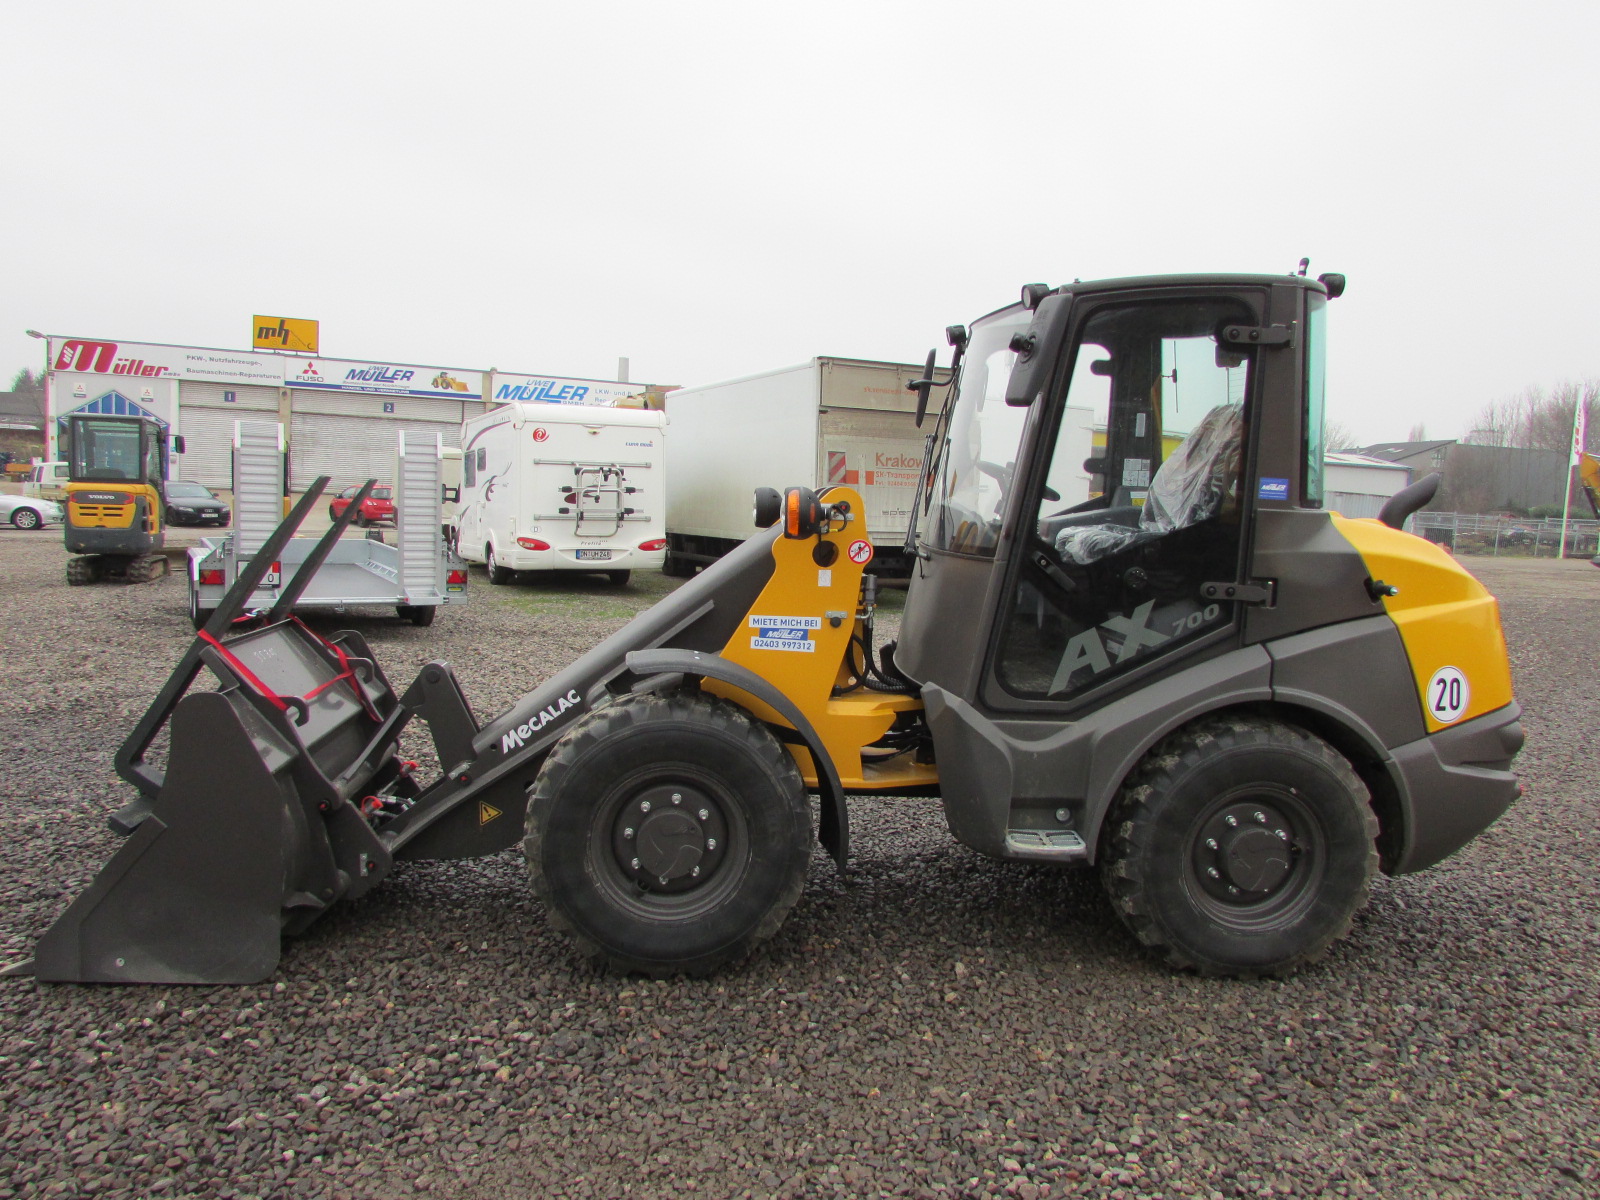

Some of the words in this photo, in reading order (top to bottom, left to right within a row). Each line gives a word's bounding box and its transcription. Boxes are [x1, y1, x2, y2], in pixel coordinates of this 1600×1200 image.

[186, 367, 281, 380] Baumaschinen-Reparaturen
[296, 375, 324, 383] FUSO
[526, 379, 550, 388] UWE
[753, 618, 778, 626] MIETE
[780, 619, 802, 627] MICH
[754, 640, 779, 648] 02403
[782, 642, 812, 650] 997312
[1047, 598, 1172, 697] AX
[1172, 603, 1220, 637] 700
[1434, 677, 1461, 711] 20
